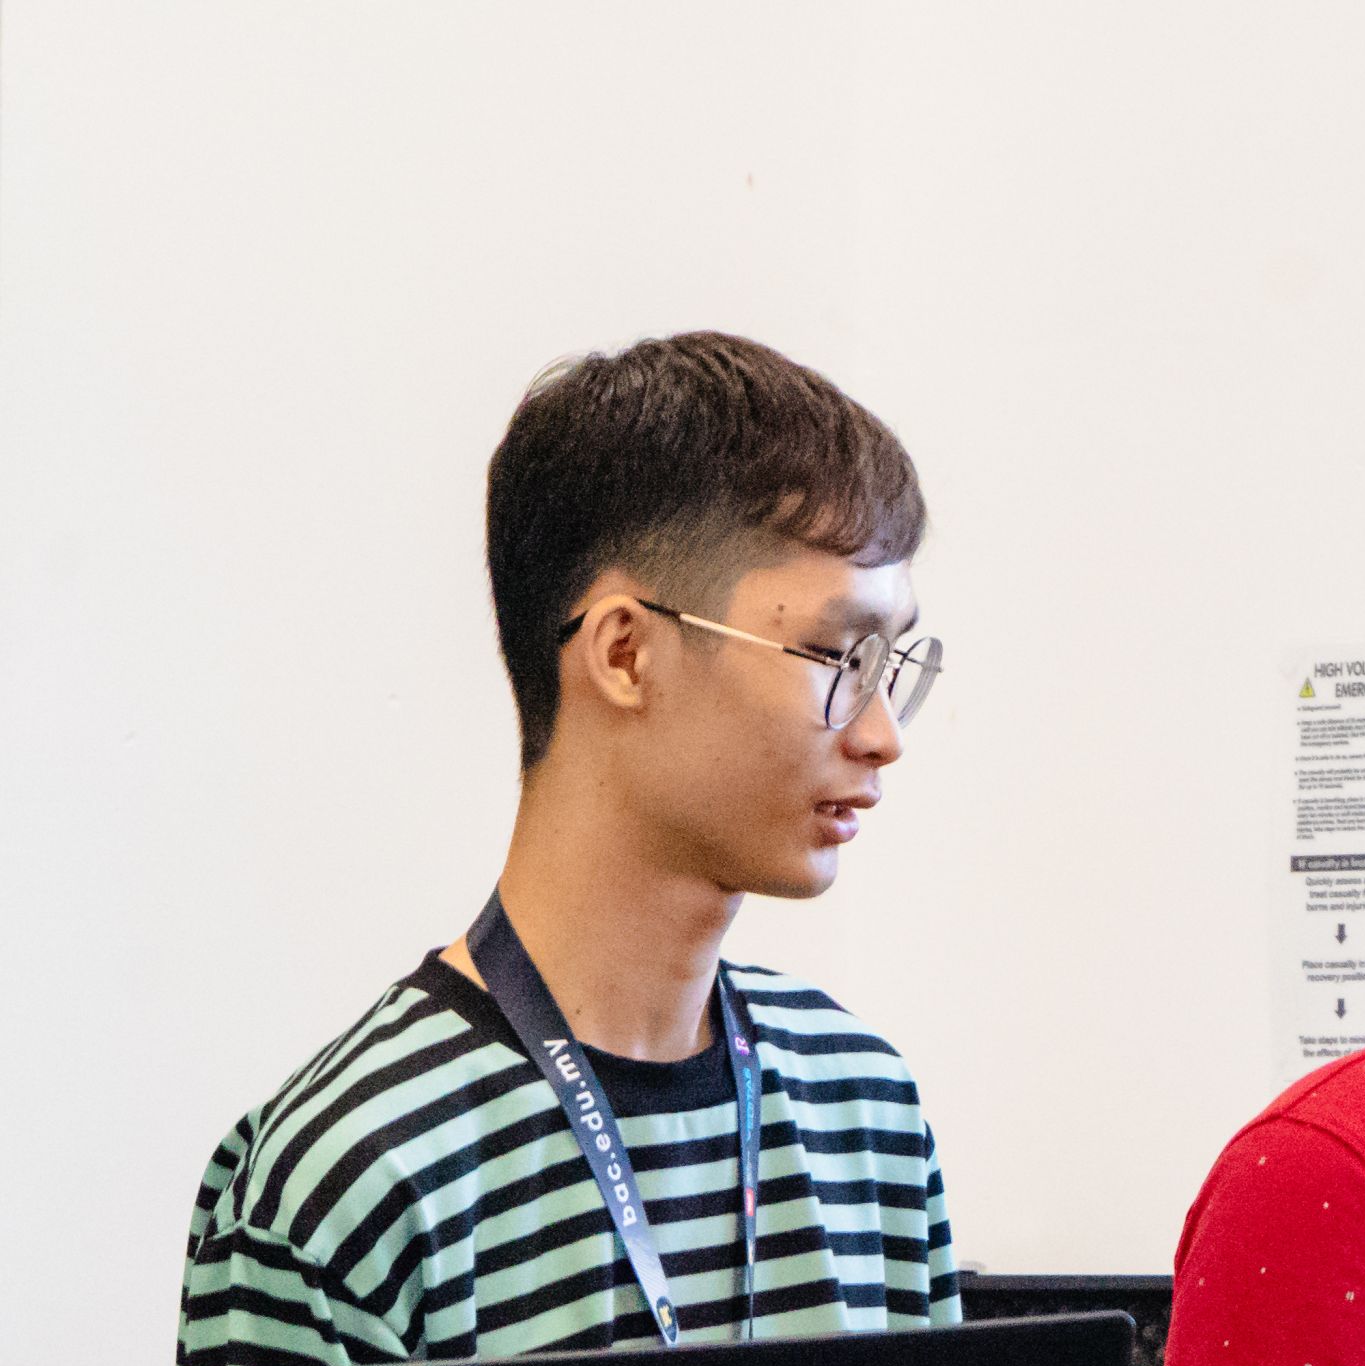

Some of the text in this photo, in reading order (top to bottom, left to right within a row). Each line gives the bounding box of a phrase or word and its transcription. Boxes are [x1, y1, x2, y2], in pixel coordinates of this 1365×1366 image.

[1314, 662, 1343, 678] HIGH
[1305, 877, 1334, 887] Quickly
[1329, 889, 1360, 899] casualty
[1330, 902, 1344, 910] and
[1325, 959, 1356, 969] casualty
[1307, 974, 1340, 983] recovery
[1303, 1049, 1314, 1057] the
[1316, 1048, 1341, 1057] effects
[543, 1038, 638, 1227] bac.edu.my
